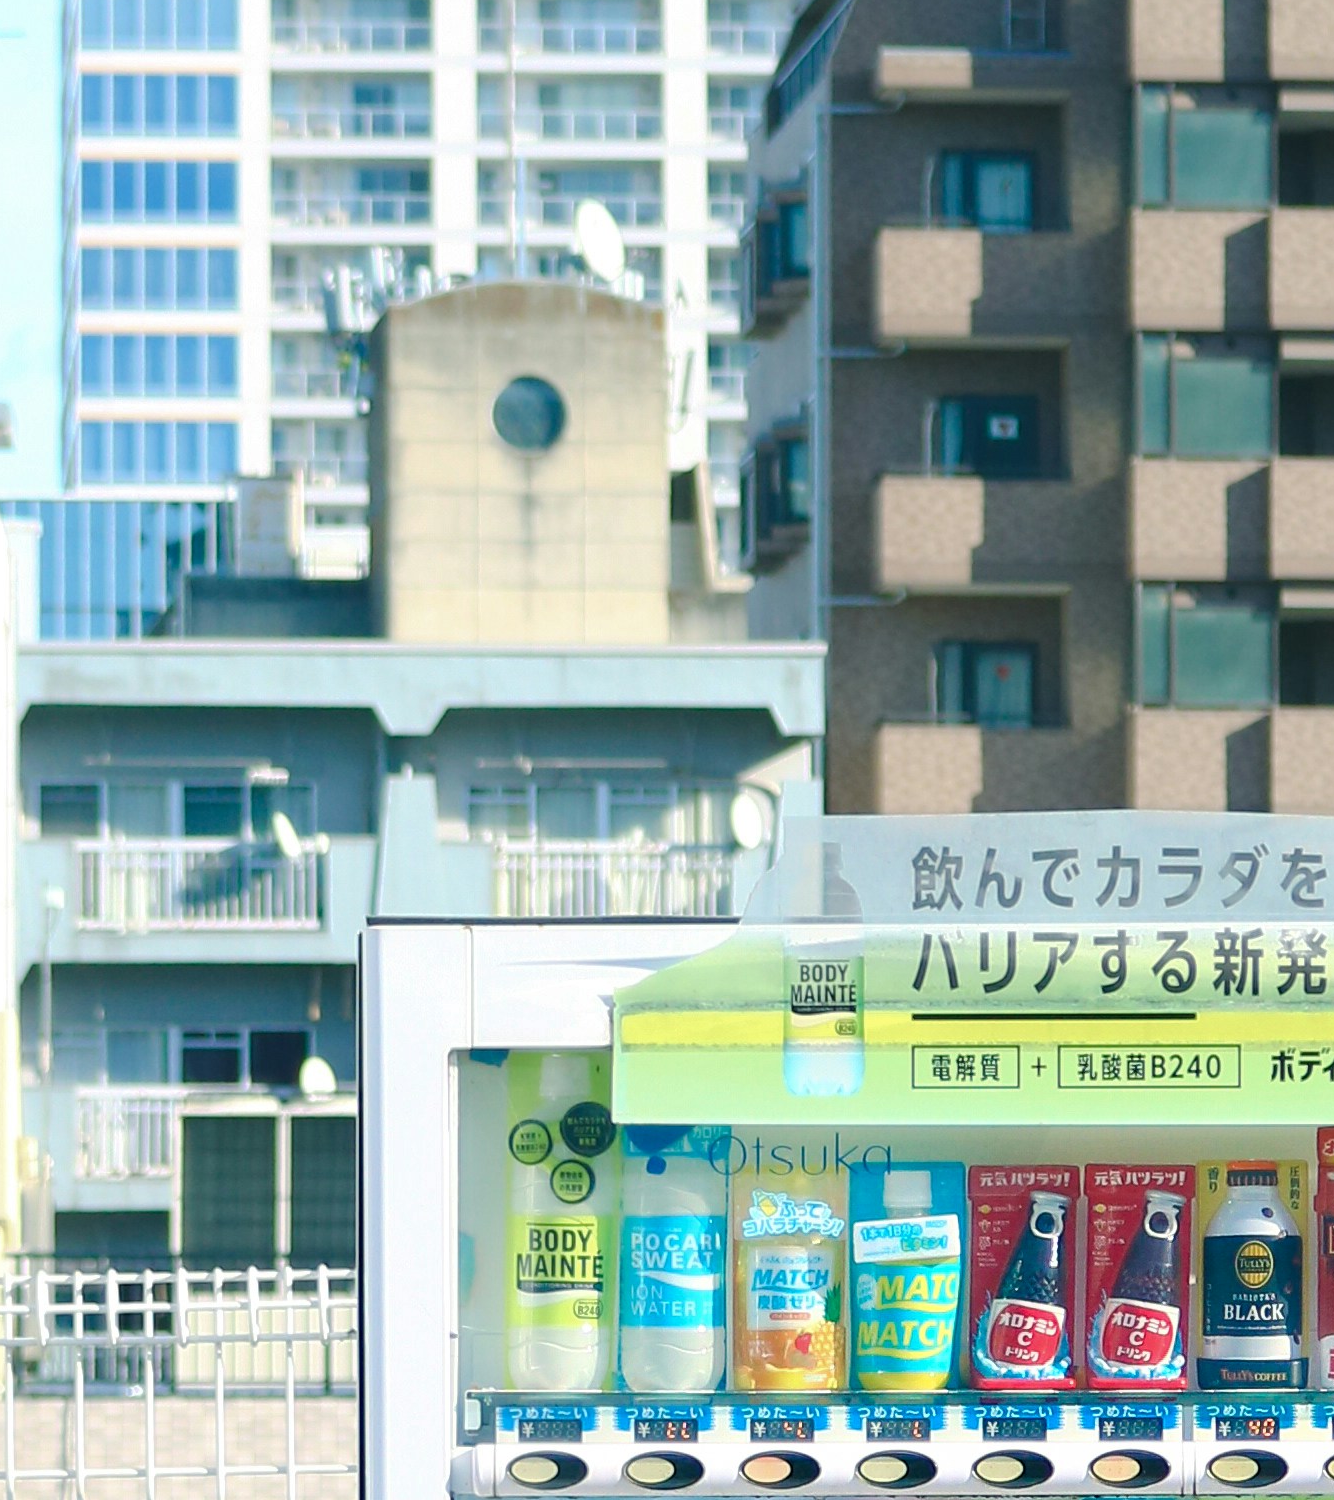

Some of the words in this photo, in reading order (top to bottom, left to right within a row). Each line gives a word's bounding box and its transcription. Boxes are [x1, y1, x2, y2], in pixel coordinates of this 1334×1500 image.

[911, 846, 1328, 911] 飲んでカラダを
[800, 964, 849, 982] BODY
[931, 1053, 1001, 1082] 電解質
[1077, 1053, 1222, 1081] 乳酸菌B240
[709, 1132, 892, 1176] Otsuka
[529, 1228, 593, 1252] BODY
[631, 1232, 721, 1251] POCARI
[517, 1251, 604, 1278] MAINTÉ
[631, 1252, 713, 1269] SWEAT
[753, 1269, 829, 1288] MATCH
[631, 1285, 663, 1300] ION
[631, 1301, 697, 1317] WATER
[1224, 1303, 1285, 1321] BLACK
[998, 1311, 1057, 1334] オロナミン
[1112, 1311, 1169, 1334] オロナミン
[858, 1320, 952, 1348] MATCH
[1018, 1332, 1033, 1346] C
[1129, 1331, 1144, 1346] C
[1005, 1346, 1039, 1362] ドリンク
[1117, 1346, 1151, 1362] ドリンク
